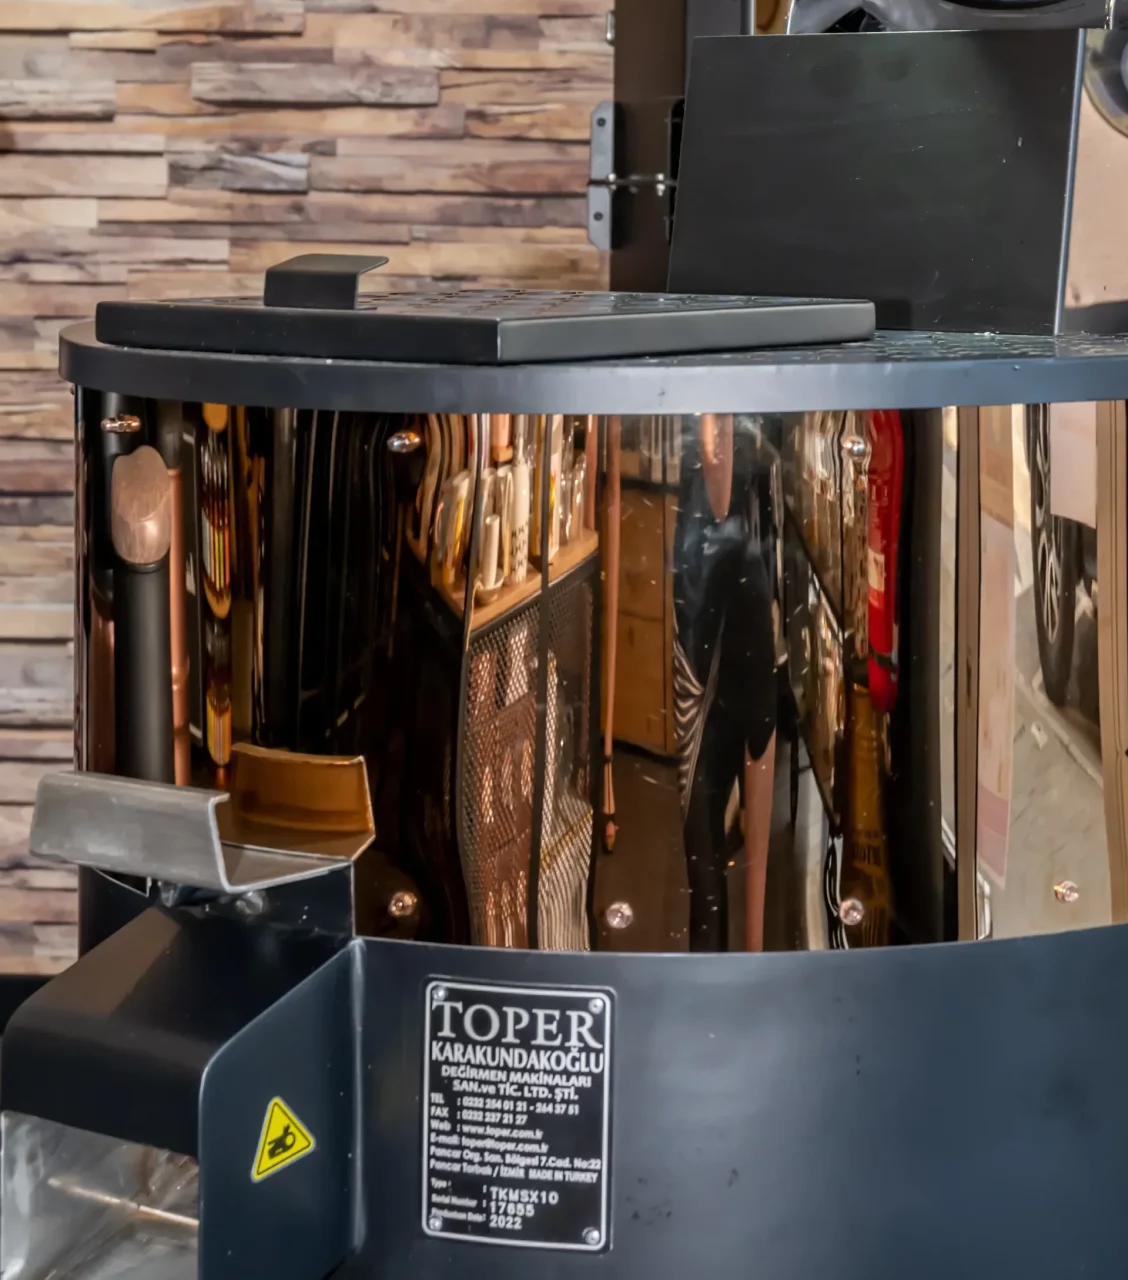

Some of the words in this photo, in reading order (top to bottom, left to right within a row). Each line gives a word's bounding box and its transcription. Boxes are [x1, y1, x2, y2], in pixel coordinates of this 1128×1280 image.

[431, 1000, 604, 1050] TOPER
[431, 1040, 604, 1074] KARAKUNDAKOĞLU
[441, 1064, 508, 1082] DEĞİRMEN
[508, 1070, 592, 1088] MAKİNALARI
[523, 1085, 552, 1099] LTD.
[430, 1106, 449, 1118] FAX
[430, 1119, 451, 1132] Web
[528, 1168, 554, 1181] MADE
[564, 1170, 599, 1183] TURKEY
[489, 1214, 523, 1230] 2022
